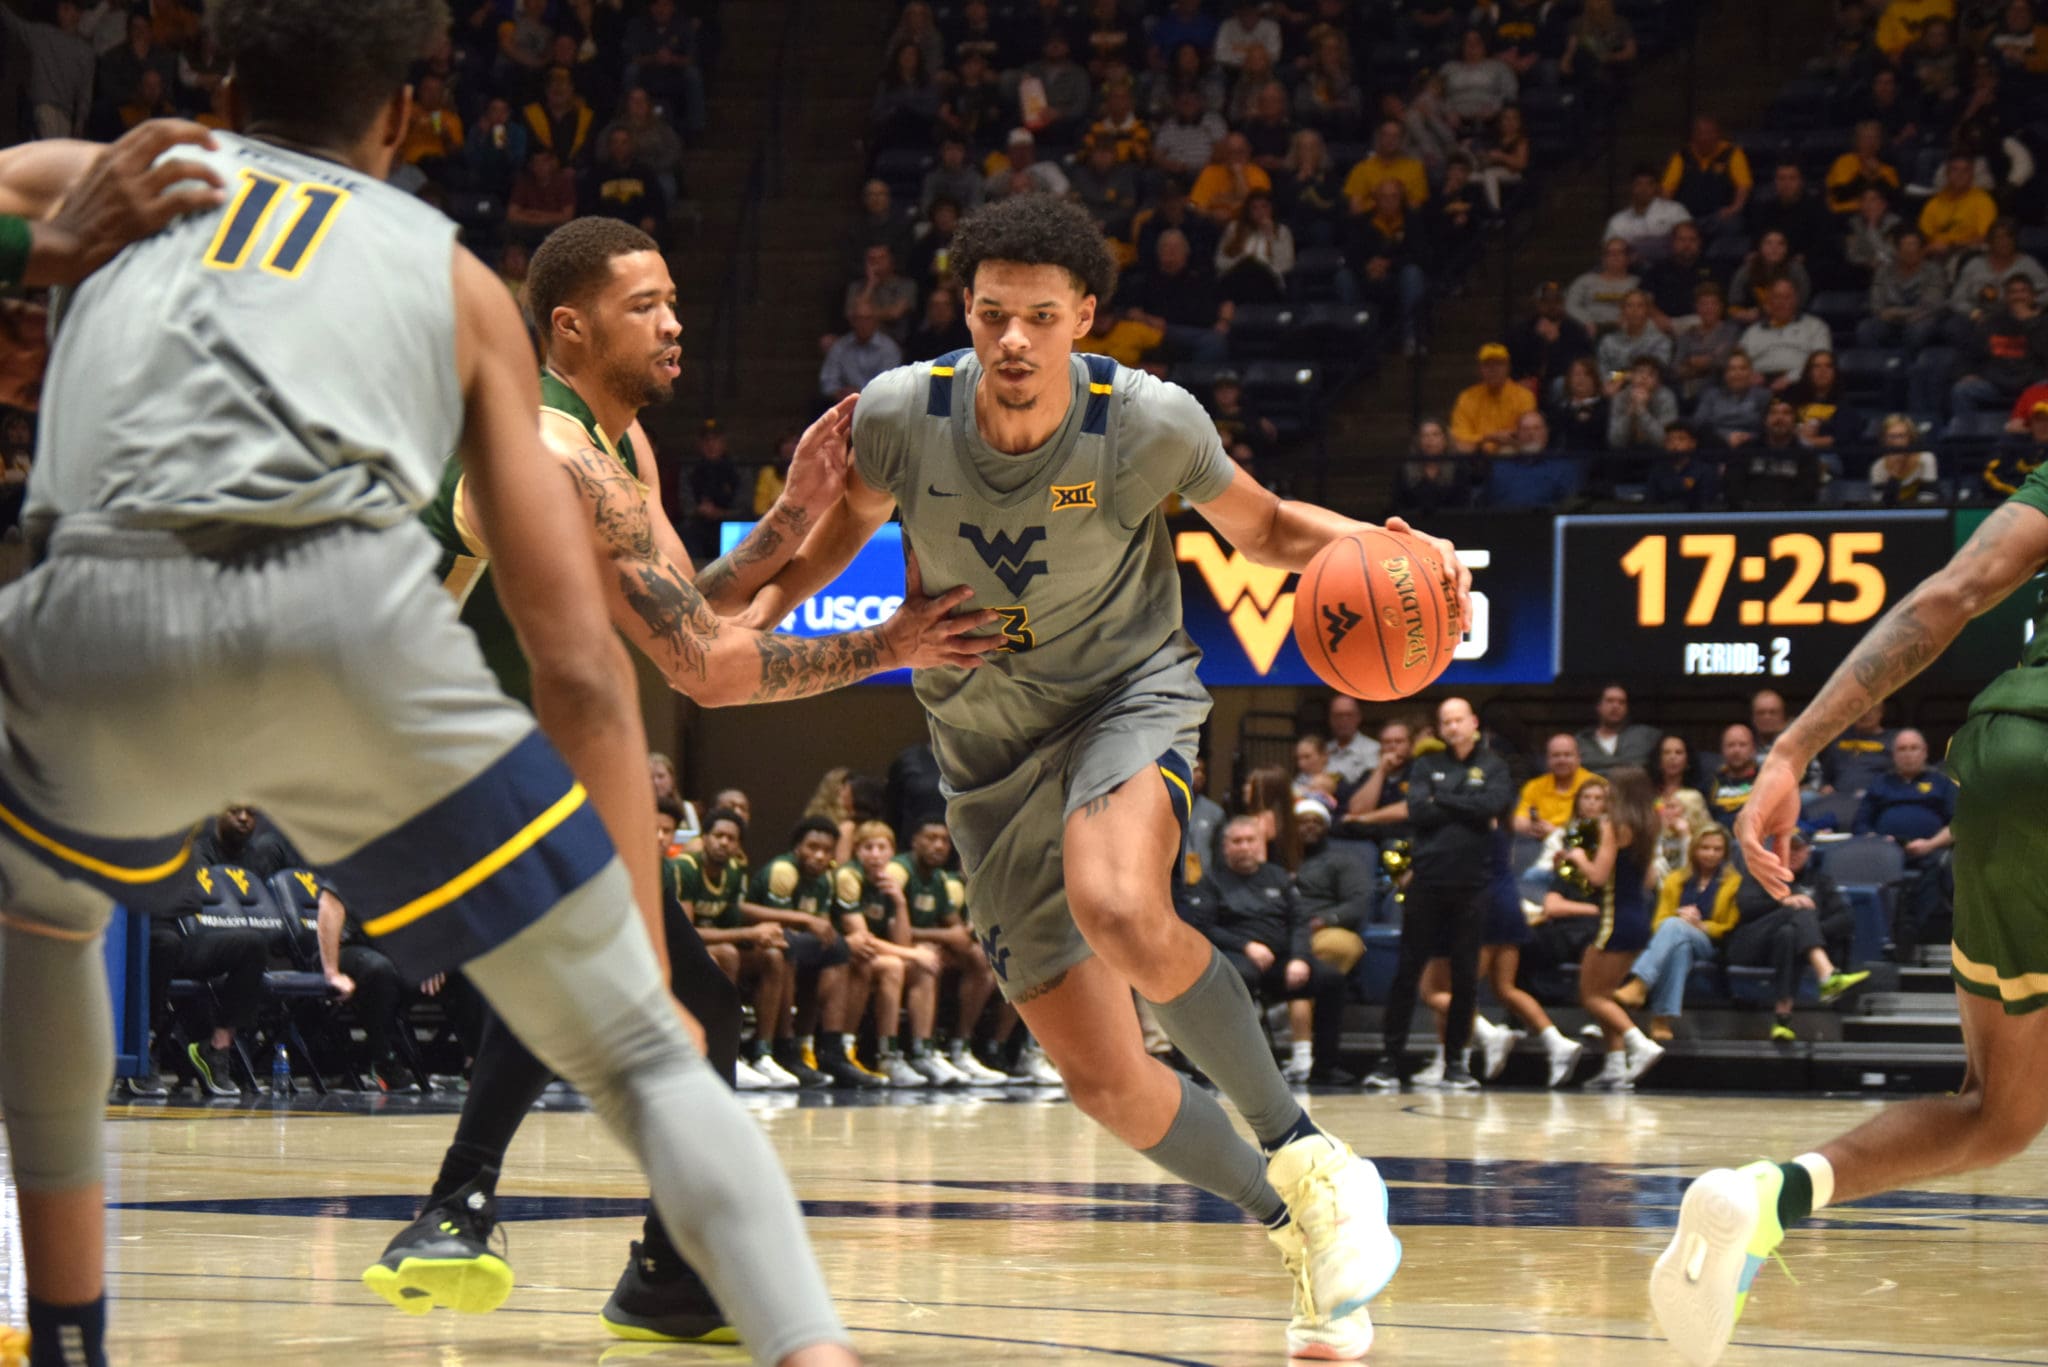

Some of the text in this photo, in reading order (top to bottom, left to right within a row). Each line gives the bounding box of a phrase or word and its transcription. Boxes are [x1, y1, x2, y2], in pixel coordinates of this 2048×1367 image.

[203, 168, 350, 280] 11
[1052, 483, 1096, 509] XII
[1381, 556, 1429, 669] SPALDING
[1620, 531, 1887, 627] 17:25
[982, 605, 1036, 653] 3
[1684, 637, 1792, 676] PERIOD: 2
